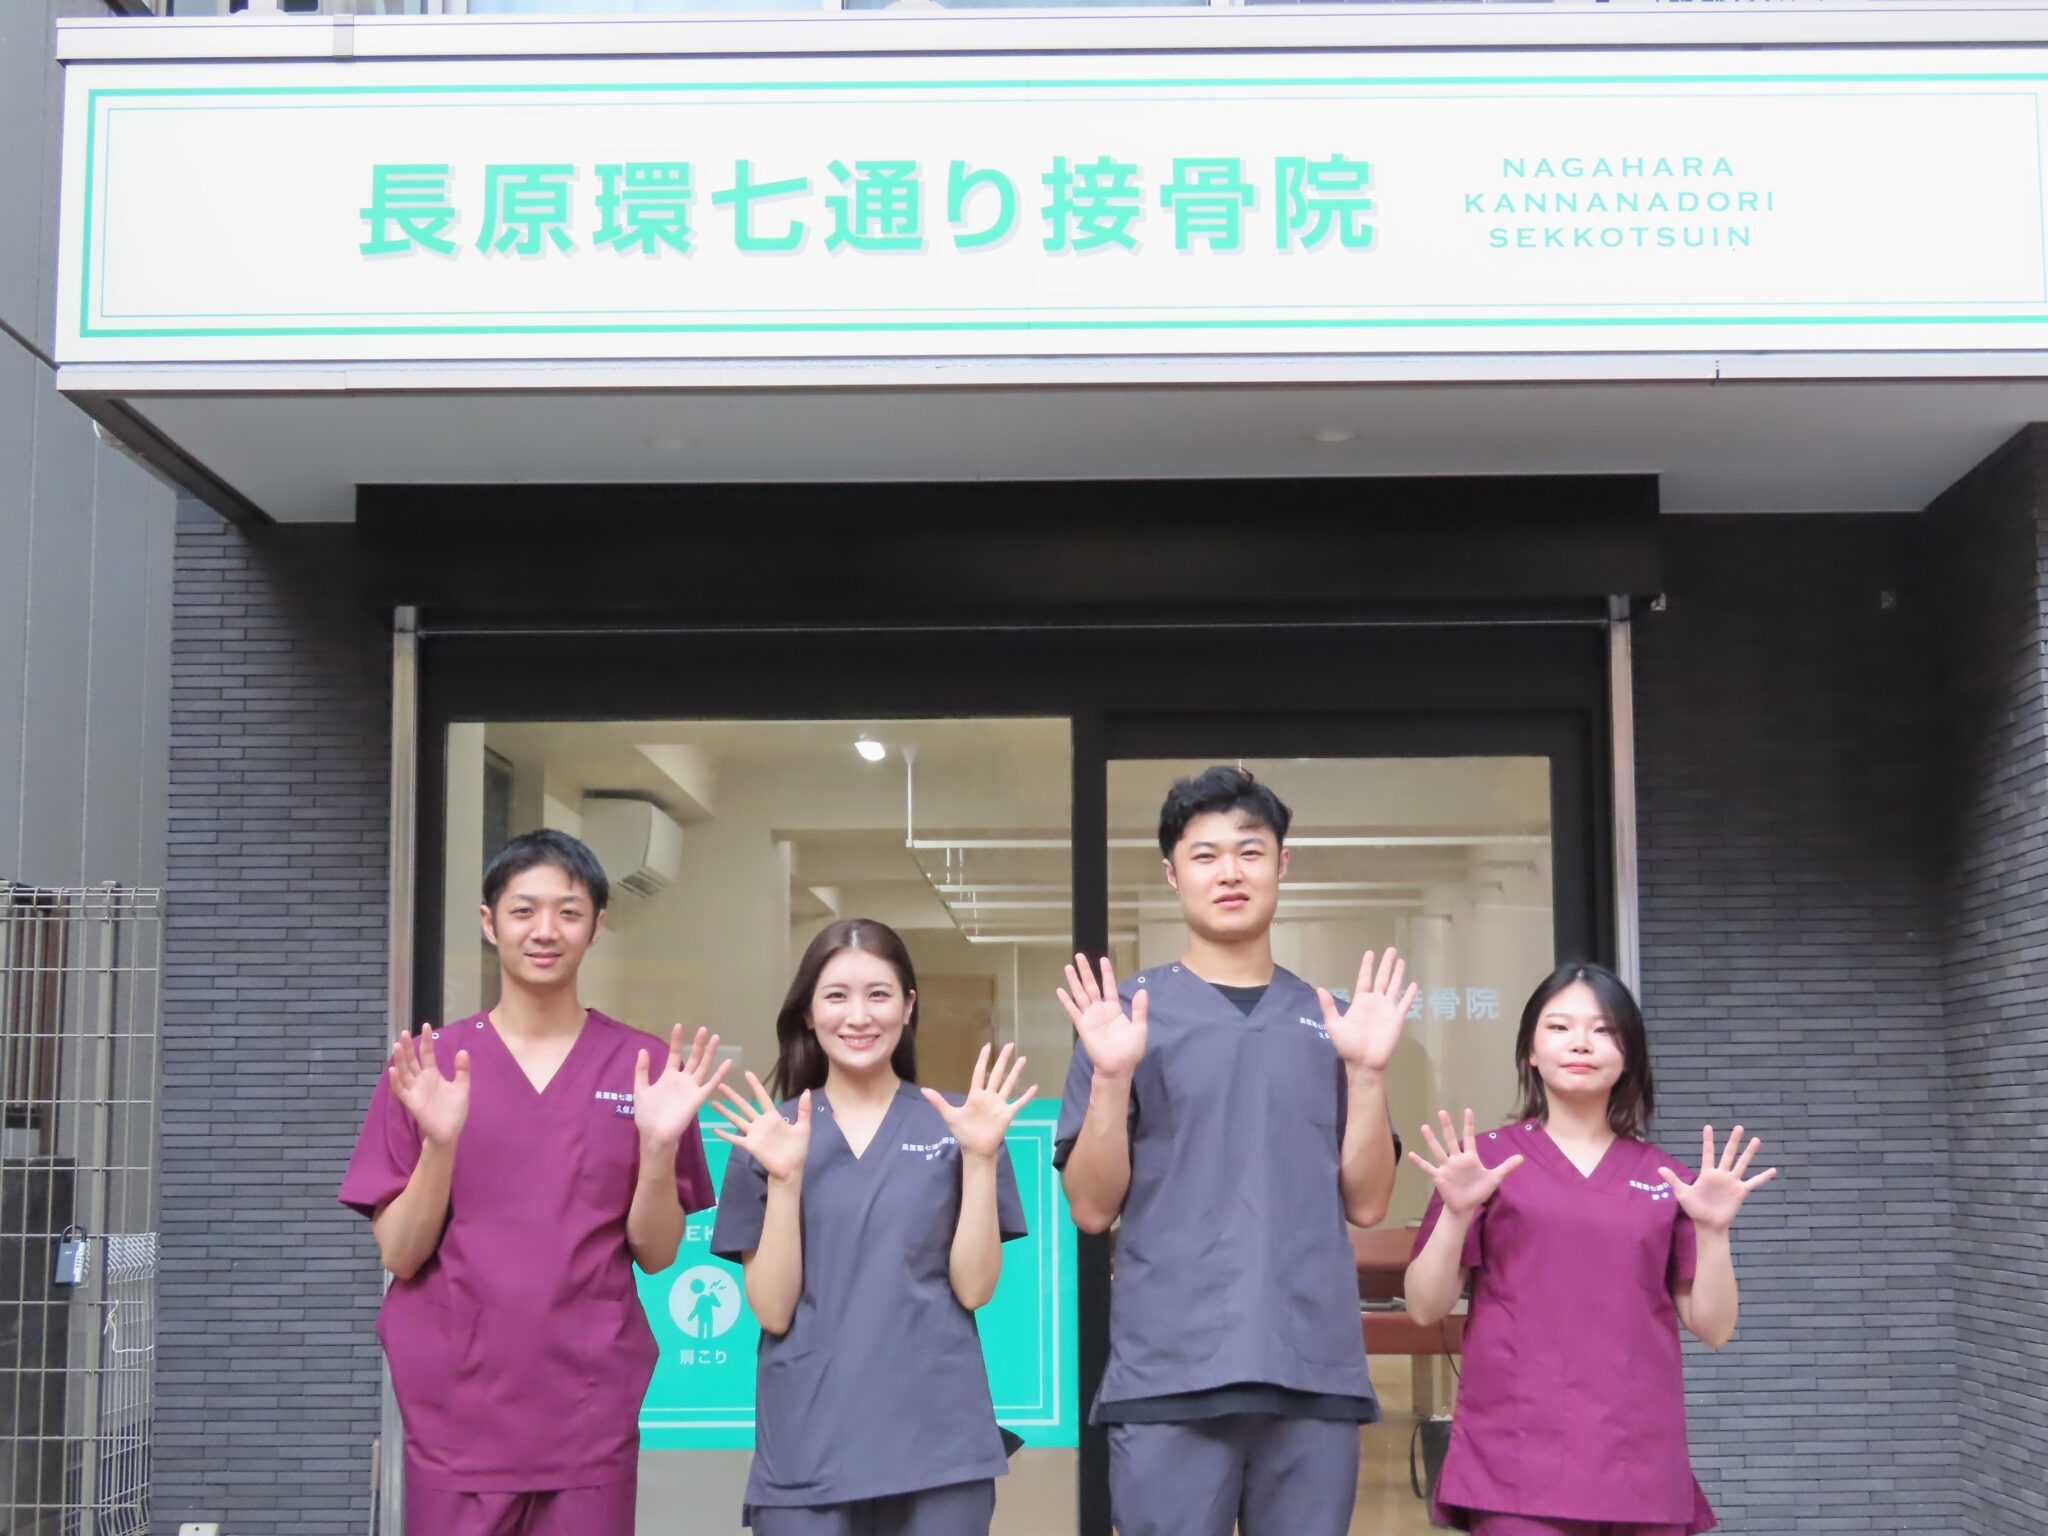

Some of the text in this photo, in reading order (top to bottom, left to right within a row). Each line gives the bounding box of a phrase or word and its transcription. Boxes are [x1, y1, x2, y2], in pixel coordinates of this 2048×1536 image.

[1503, 156, 1733, 178] NAGAHARA
[360, 154, 1376, 256] 長原環七通り接骨院
[1464, 191, 1773, 214] KANNANADORI
[1489, 226, 1750, 249] SEKKOTSUIN
[680, 1349, 727, 1365] 肩こり
